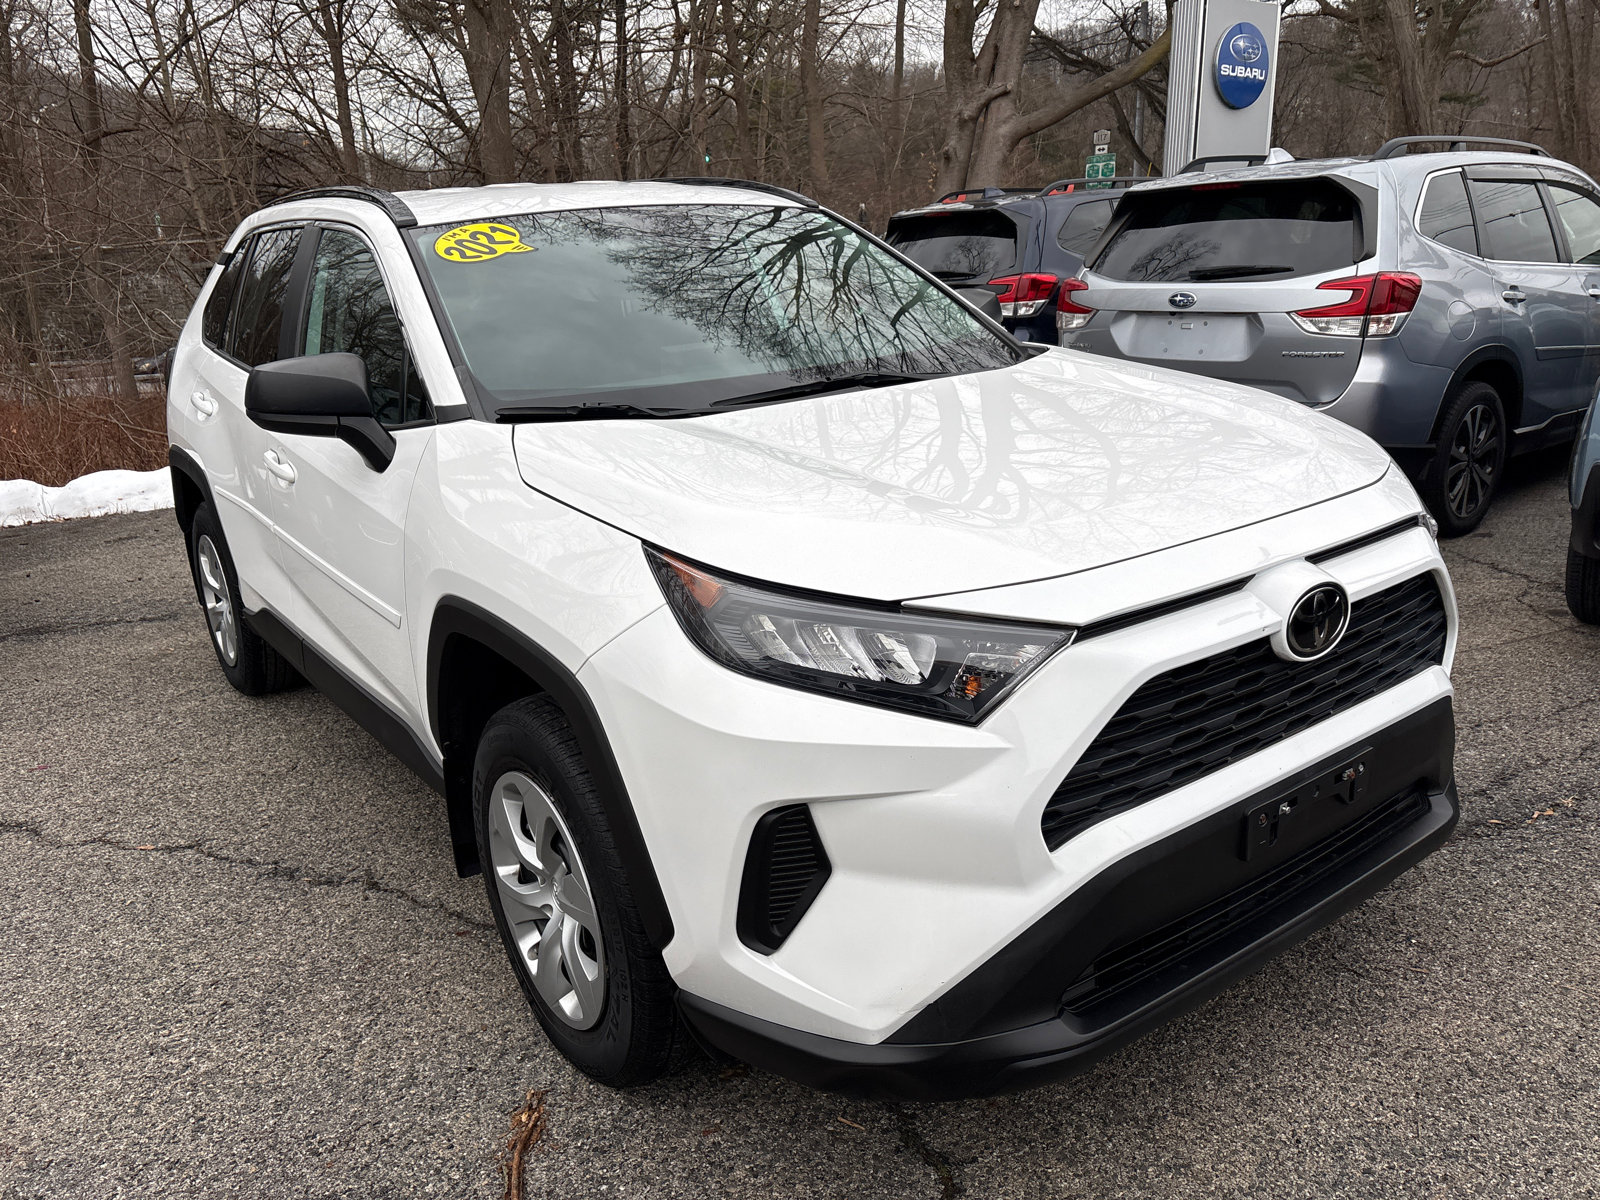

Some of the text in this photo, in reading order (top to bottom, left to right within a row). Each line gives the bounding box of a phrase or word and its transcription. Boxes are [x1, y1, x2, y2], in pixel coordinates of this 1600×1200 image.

[1221, 64, 1265, 80] SUBARU
[442, 231, 461, 242] I'M
[444, 225, 517, 259] 2021
